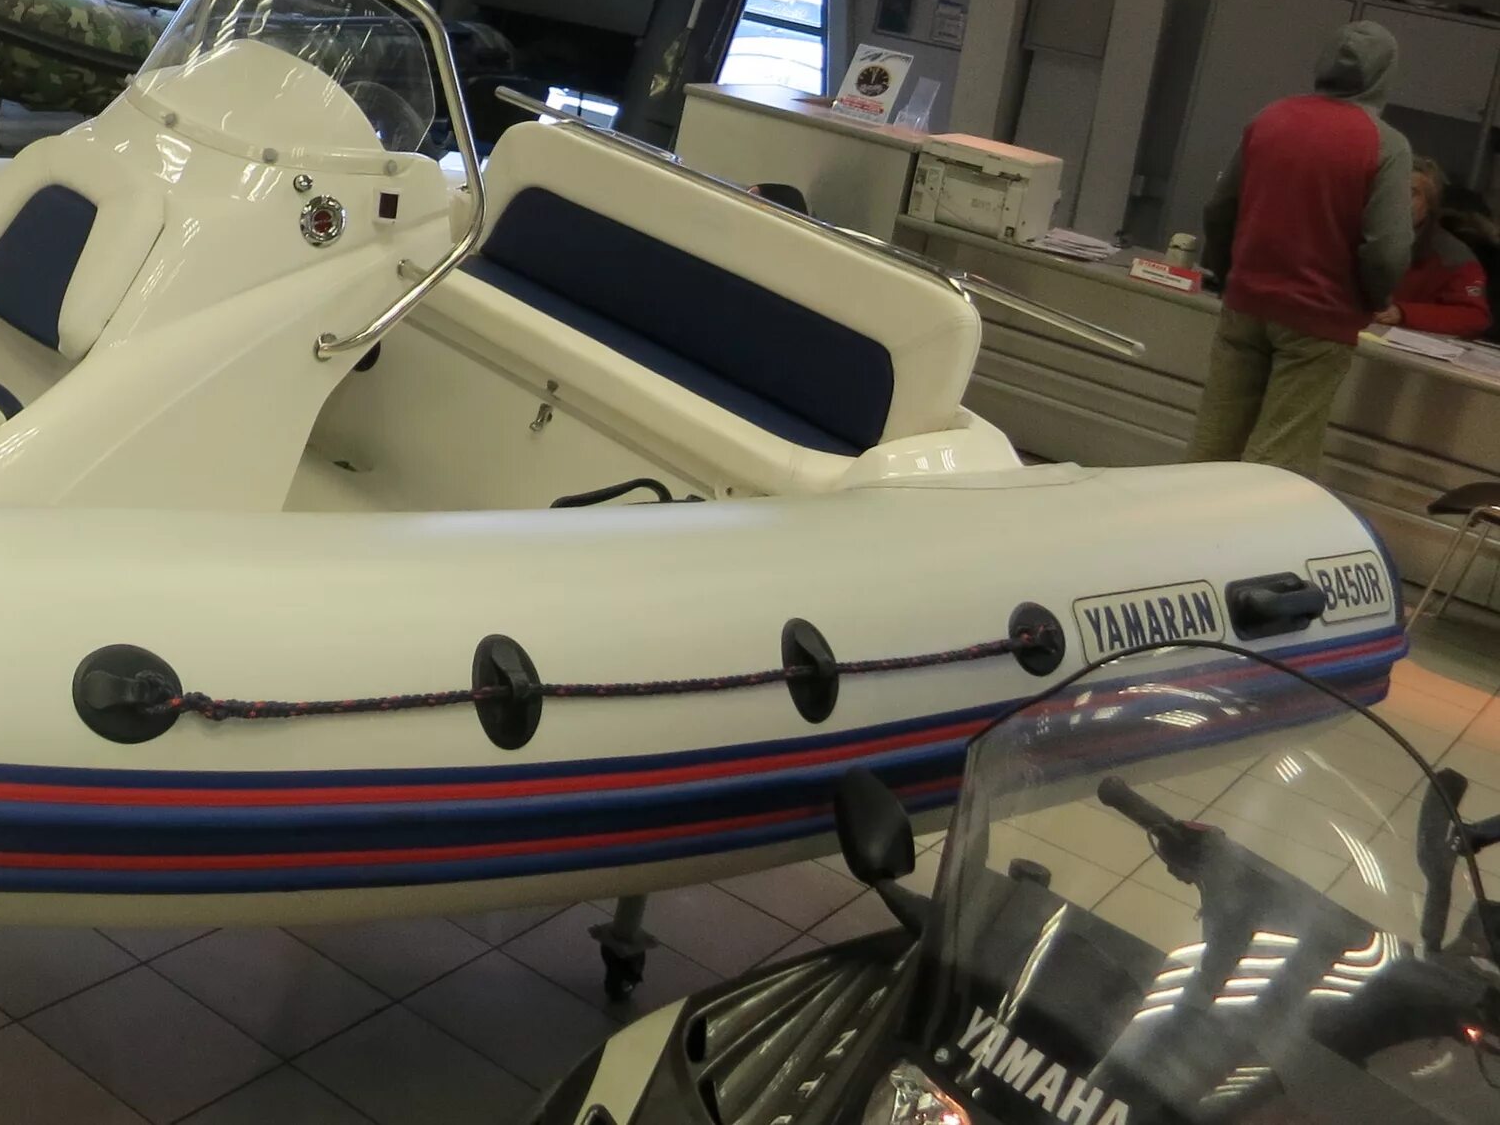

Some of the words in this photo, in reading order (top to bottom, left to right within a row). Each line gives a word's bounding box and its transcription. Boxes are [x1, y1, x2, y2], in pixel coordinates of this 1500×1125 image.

[1316, 562, 1385, 611] B450R
[1084, 590, 1217, 653] YAMARAN
[957, 1005, 1130, 1125] YAMAHA
